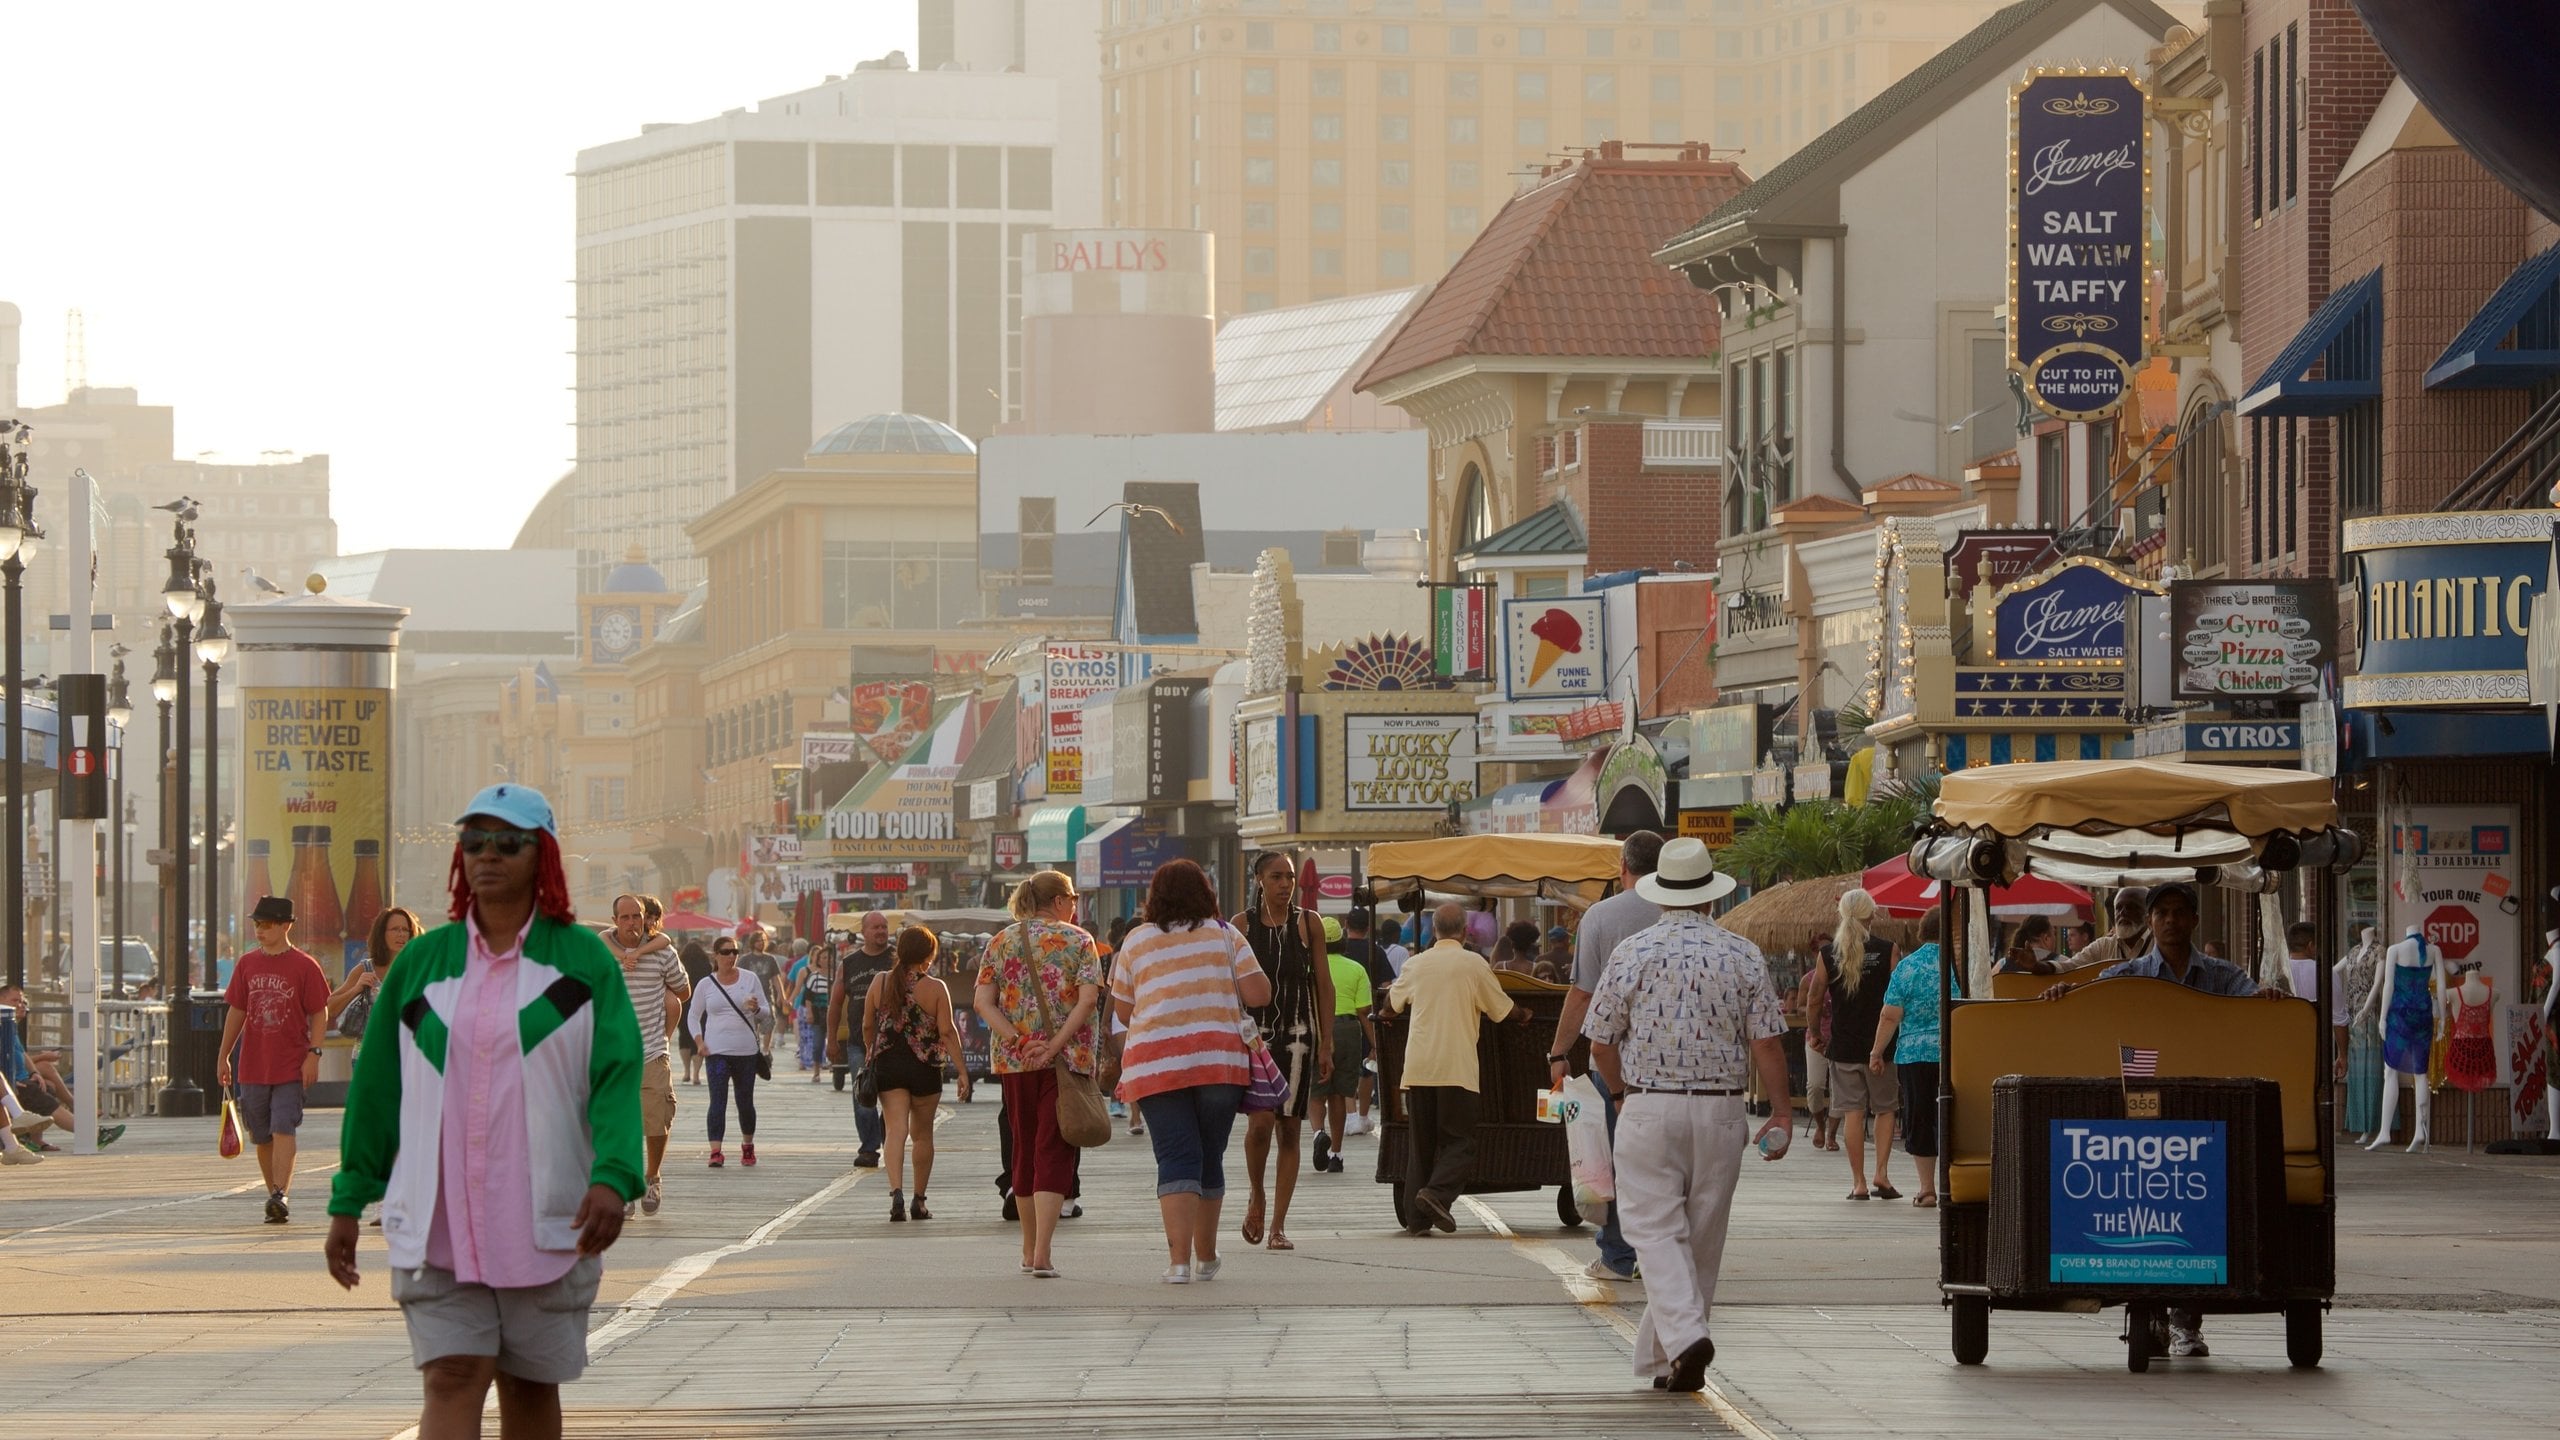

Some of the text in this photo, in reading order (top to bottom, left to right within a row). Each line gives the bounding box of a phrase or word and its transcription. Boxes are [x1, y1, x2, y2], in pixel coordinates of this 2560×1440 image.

[2043, 211, 2117, 234] SALT
[1054, 239, 1168, 272] BALLY'S
[2033, 280, 2127, 302] TAFFY
[2041, 368, 2117, 380] CUT TO FIT
[2038, 383, 2119, 394] THE MOUTH
[1993, 560, 2035, 575] IZZA
[2205, 595, 2298, 606] THREE BROTHERS
[2371, 575, 2532, 641] ATLANTIC
[2272, 606, 2299, 615] PIZZA
[1456, 593, 1465, 670] STROMBOLI
[2227, 614, 2279, 638] Gyro
[2188, 633, 2210, 641] GYROS
[1516, 611, 1525, 684] WAFFLES
[2048, 646, 2123, 658] SALT WATER
[2220, 641, 2285, 665] Pizza
[1050, 661, 1116, 677] GYROS
[1557, 667, 1591, 677] FUNNEL
[1052, 678, 1115, 687] SOUVLAKI
[1561, 677, 1587, 688] CAKE
[2218, 670, 2283, 690] Chicken
[1050, 687, 1118, 699] BREAKF
[1155, 686, 1190, 697] BODY
[248, 699, 377, 721] STRAIGHT UP
[1412, 720, 1440, 728] PLAYING
[267, 725, 360, 746] BREWED
[1367, 728, 1462, 757] LUCKY
[2202, 726, 2291, 748] GYROS
[808, 742, 852, 754] PIZZ
[254, 750, 374, 772] TEA TASTE.
[1375, 757, 1449, 781] LOU'S
[1350, 780, 1473, 804] TATTOOS
[286, 797, 338, 813] Wawa
[825, 811, 881, 839] FOOD
[886, 811, 954, 839] COURT
[1687, 816, 1726, 828] HENNA
[996, 837, 1020, 855] ATM
[2434, 856, 2501, 866] BOARDWALK
[789, 873, 830, 892] Henna
[873, 876, 908, 892] SUBS
[2421, 888, 2482, 903] YOUR ONE
[2428, 923, 2476, 943] STOP
[2455, 961, 2482, 975] HOP
[2511, 1011, 2542, 1085] SALE
[2128, 1098, 2157, 1111] 355
[2063, 1128, 2207, 1170] Tanger
[2063, 1161, 2208, 1200] Outlets
[2060, 1258, 2217, 1269] OVER 95 BRAND NAME OUTLETS
